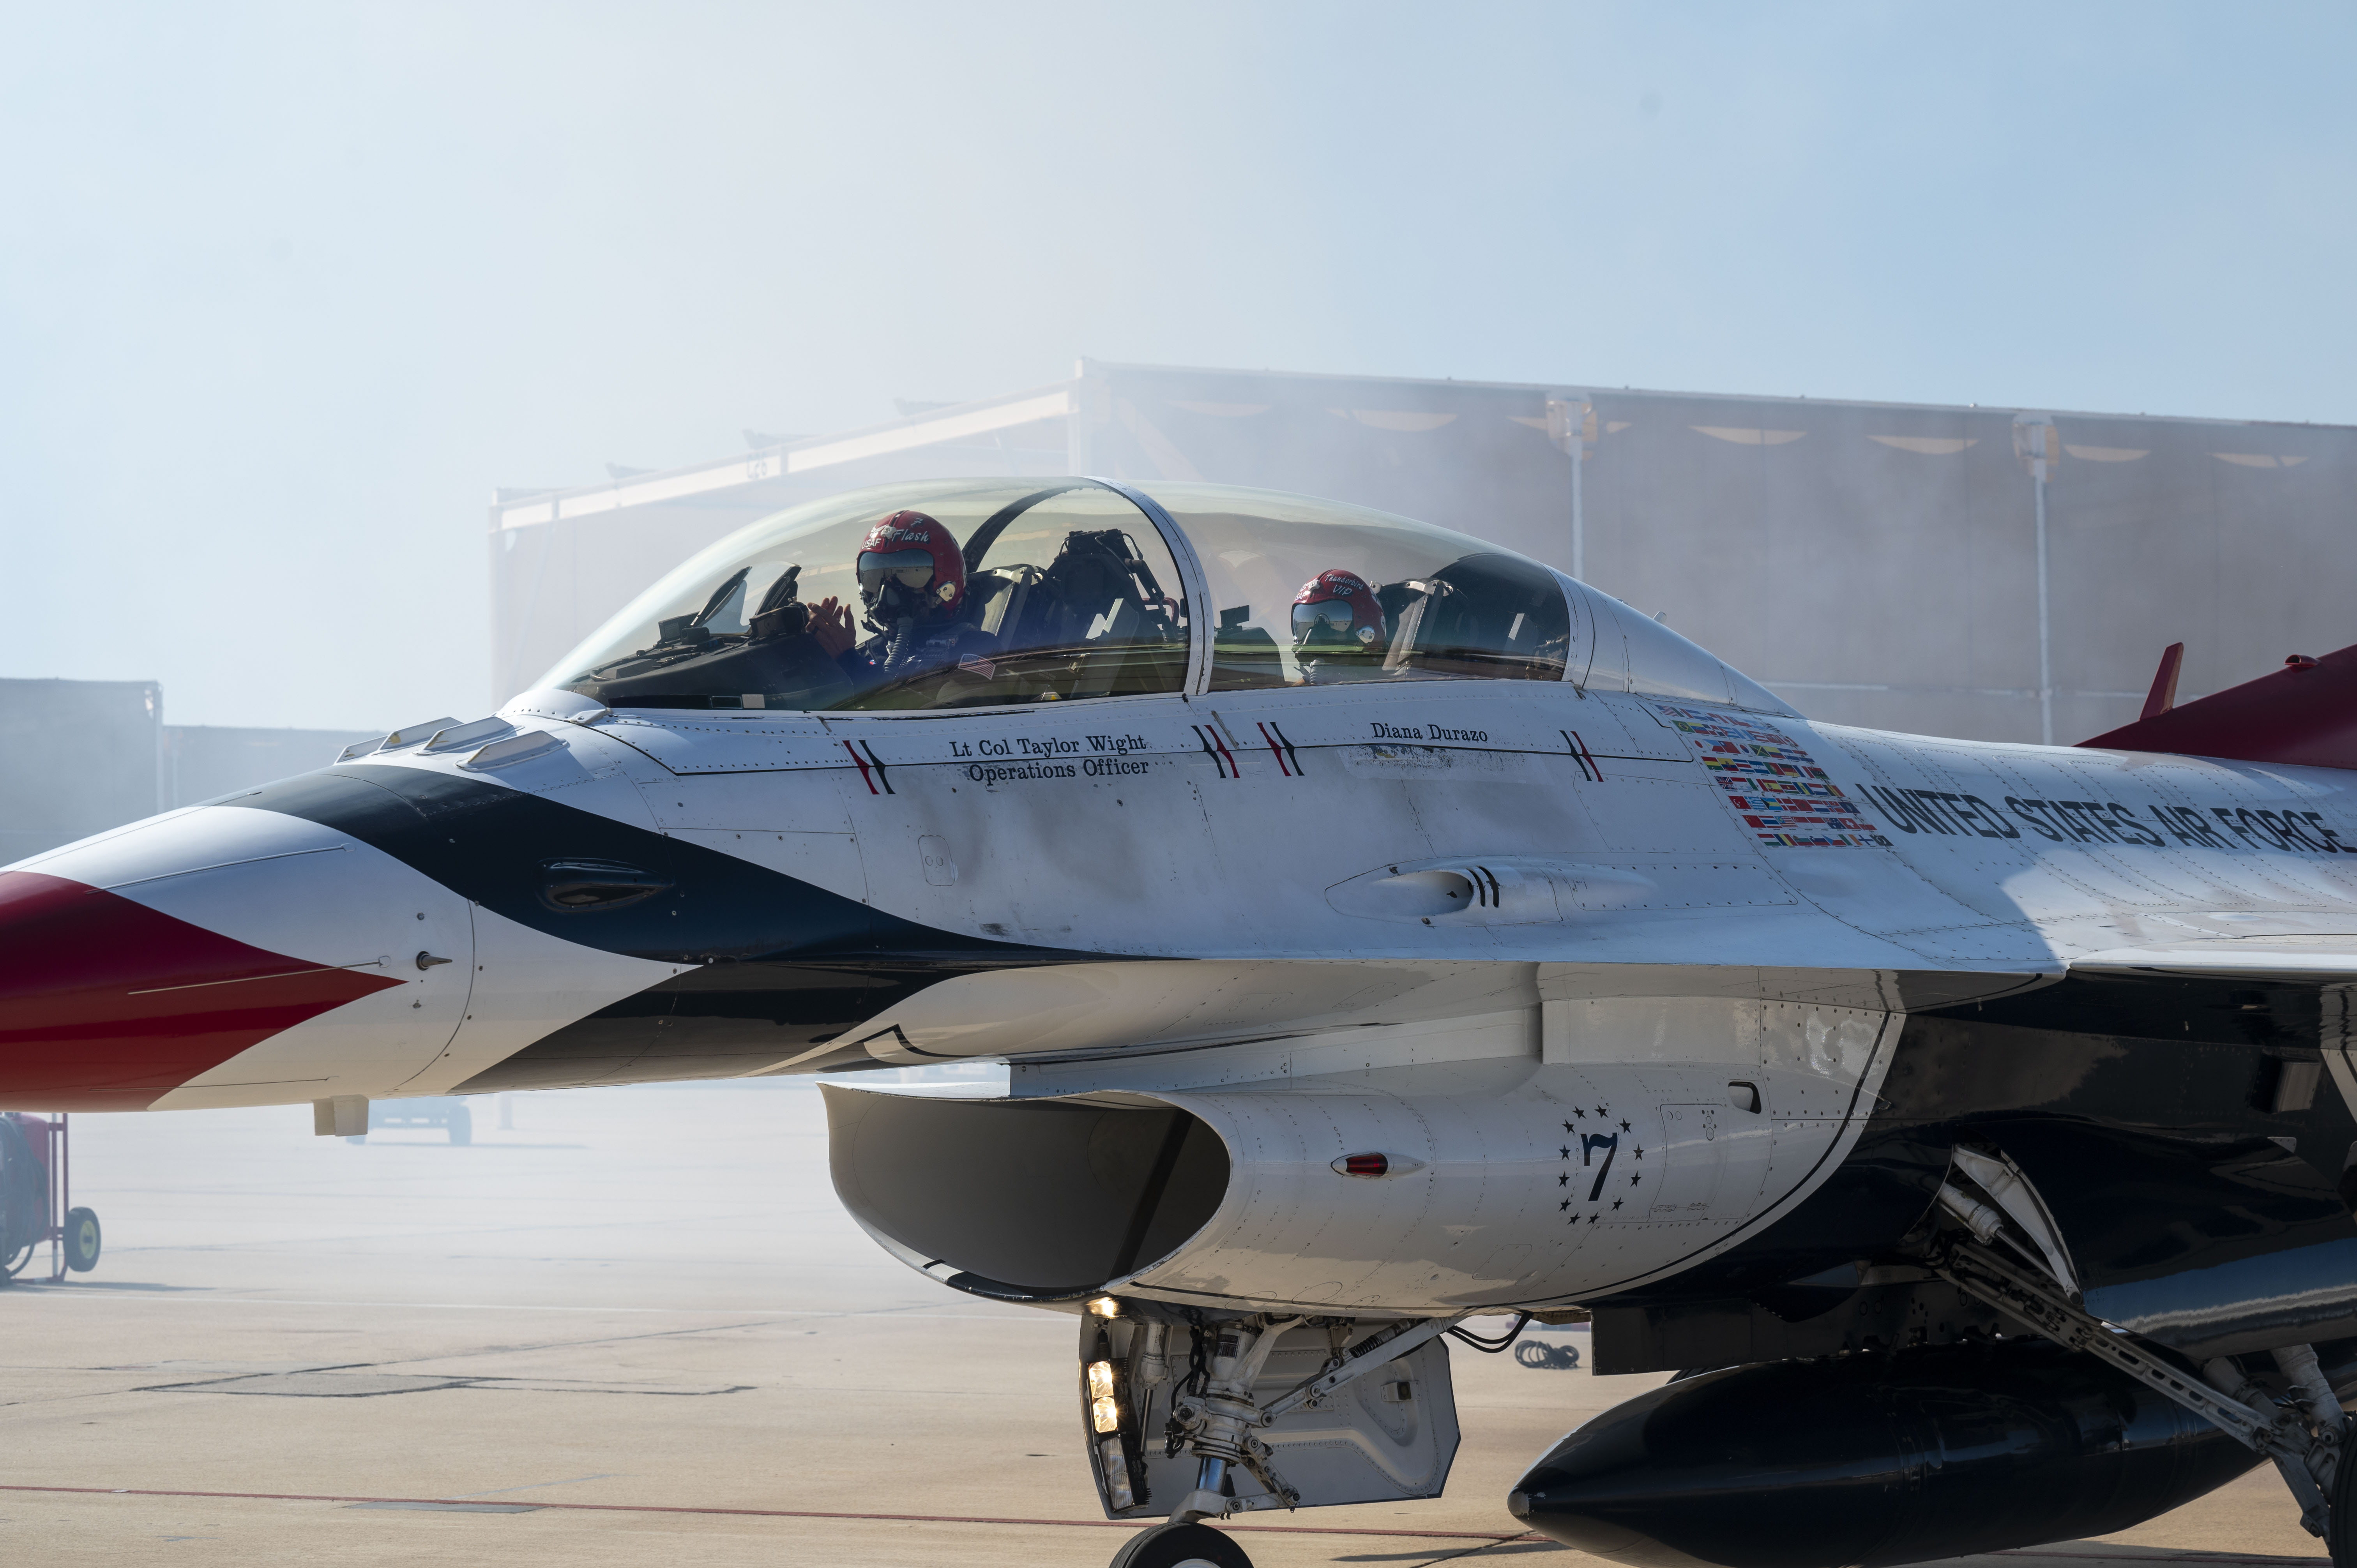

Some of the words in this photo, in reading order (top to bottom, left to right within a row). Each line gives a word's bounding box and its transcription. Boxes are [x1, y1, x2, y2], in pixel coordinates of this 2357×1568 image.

[862, 538, 882, 549] USAF
[892, 529, 929, 542] Flash
[1325, 574, 1364, 590] Thunderbird
[1333, 584, 1352, 595] VIP
[1294, 591, 1310, 602] SAF
[1370, 723, 1422, 738] Diana
[1427, 724, 1488, 742] Durazo
[949, 742, 972, 757] Lt
[979, 740, 1012, 755] Col
[1017, 738, 1079, 758] Taylor
[1086, 735, 1147, 755] Wight
[969, 762, 1076, 786] Operations
[1083, 758, 1148, 776] Officer
[1855, 783, 2021, 839] UNITED
[2004, 796, 2166, 847] STATES
[2148, 805, 2238, 849] AIR
[2209, 807, 2357, 853] FORCE
[1580, 1132, 1617, 1201] 7
